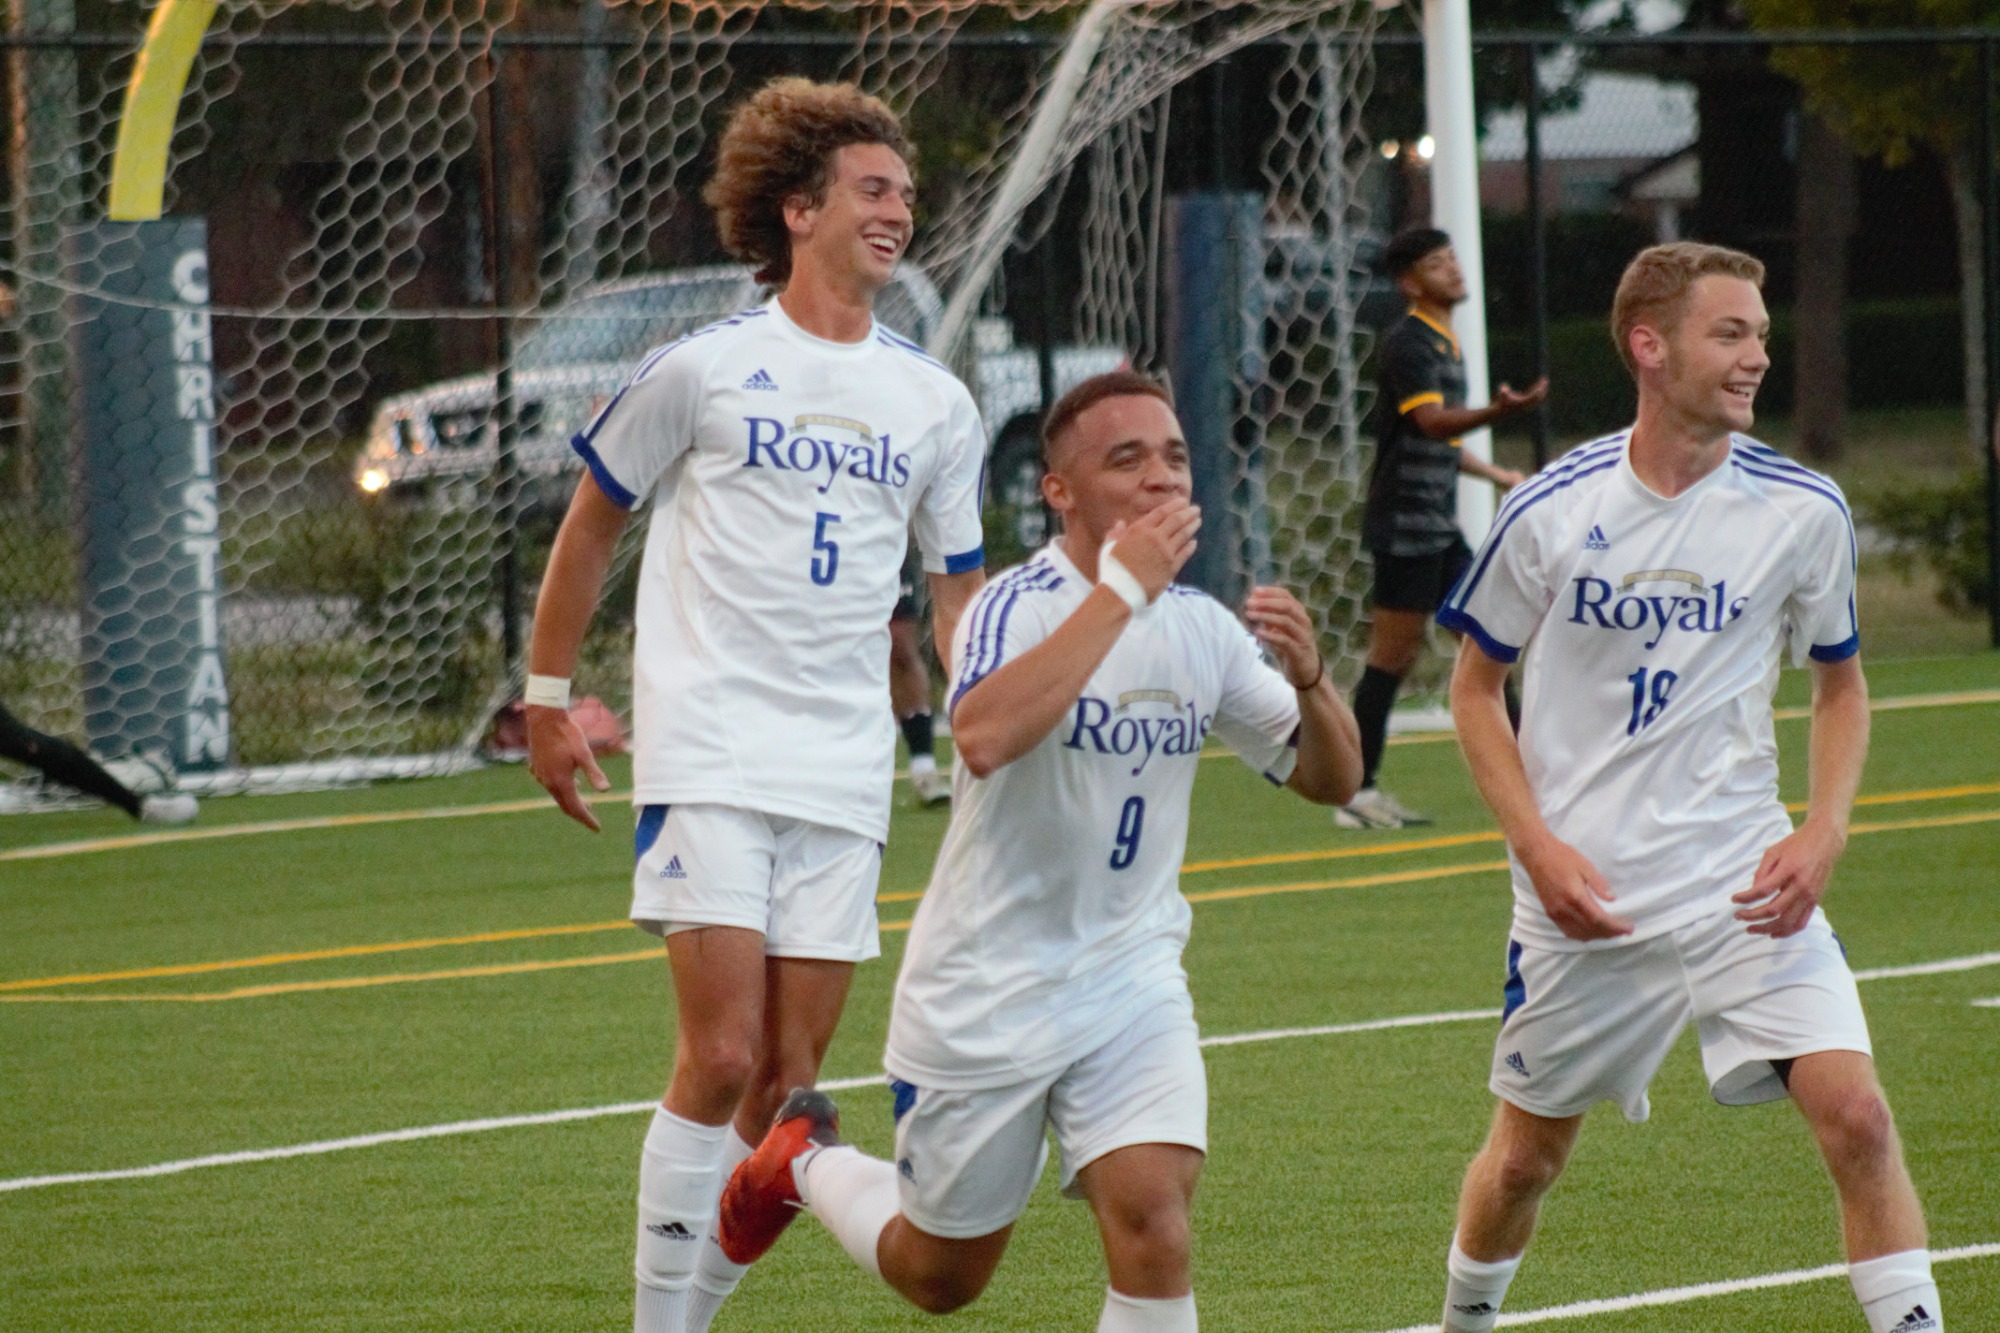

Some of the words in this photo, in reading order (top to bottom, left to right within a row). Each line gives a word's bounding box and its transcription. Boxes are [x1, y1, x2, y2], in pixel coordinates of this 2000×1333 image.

[742, 382, 779, 391] adidas
[742, 416, 911, 495] Royals
[172, 250, 229, 763] CHRISTIAN
[810, 511, 842, 587] 5
[1627, 666, 1678, 737] 18
[1109, 795, 1146, 871] 9
[660, 869, 688, 879] adidas
